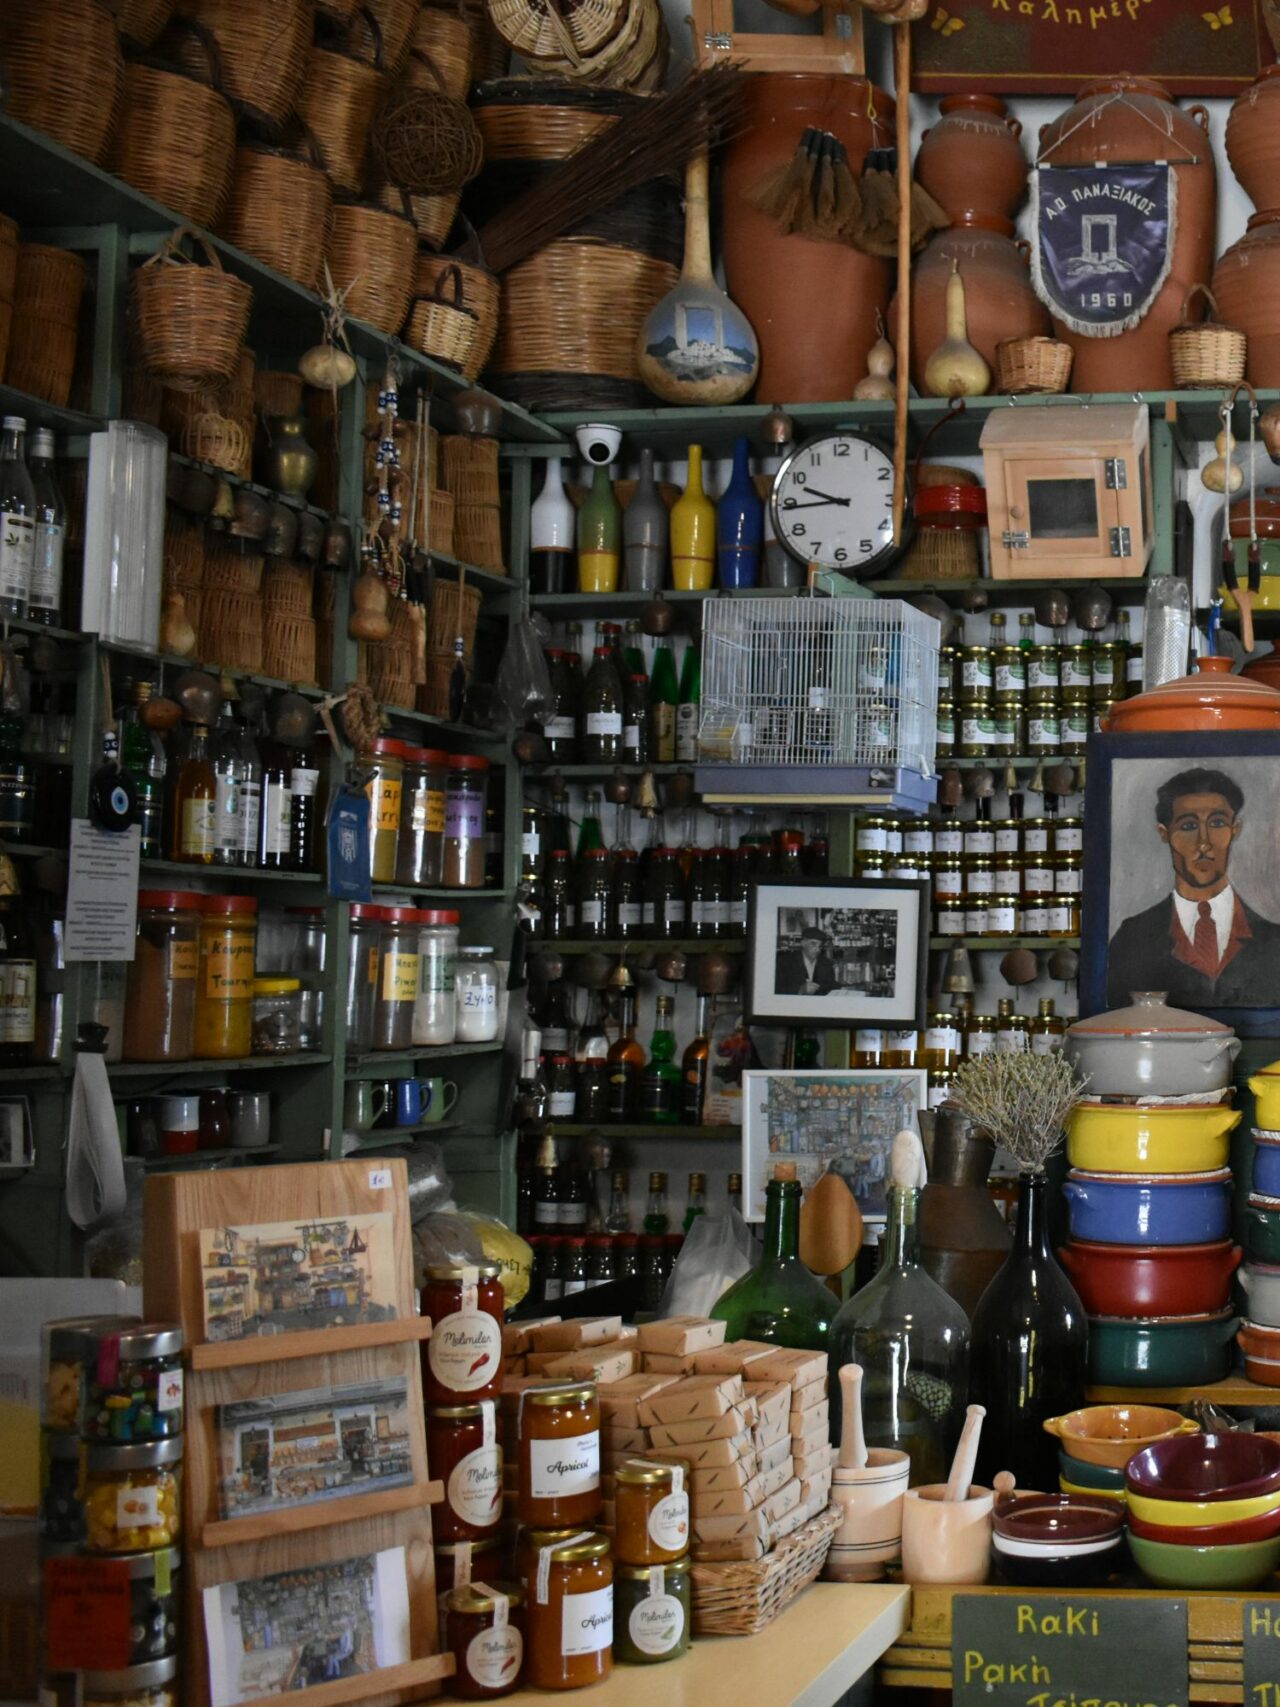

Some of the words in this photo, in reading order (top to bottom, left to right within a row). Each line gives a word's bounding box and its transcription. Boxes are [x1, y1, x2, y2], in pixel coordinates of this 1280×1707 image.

[992, 0, 1152, 29] αλημέρ
[1072, 183, 1156, 215] ΠΑΝΑΞΙΑΚΟΣ
[1081, 293, 1132, 307] 1960
[833, 443, 850, 457] 12
[811, 453, 820, 466] 11
[793, 472, 806, 484] 10
[877, 467, 891, 480] 2
[792, 523, 806, 536] 8
[877, 519, 890, 530] 4
[810, 542, 822, 555] 7
[859, 540, 873, 552] 5
[834, 548, 848, 561] 6
[964, 1651, 1050, 1685] Ρακή
